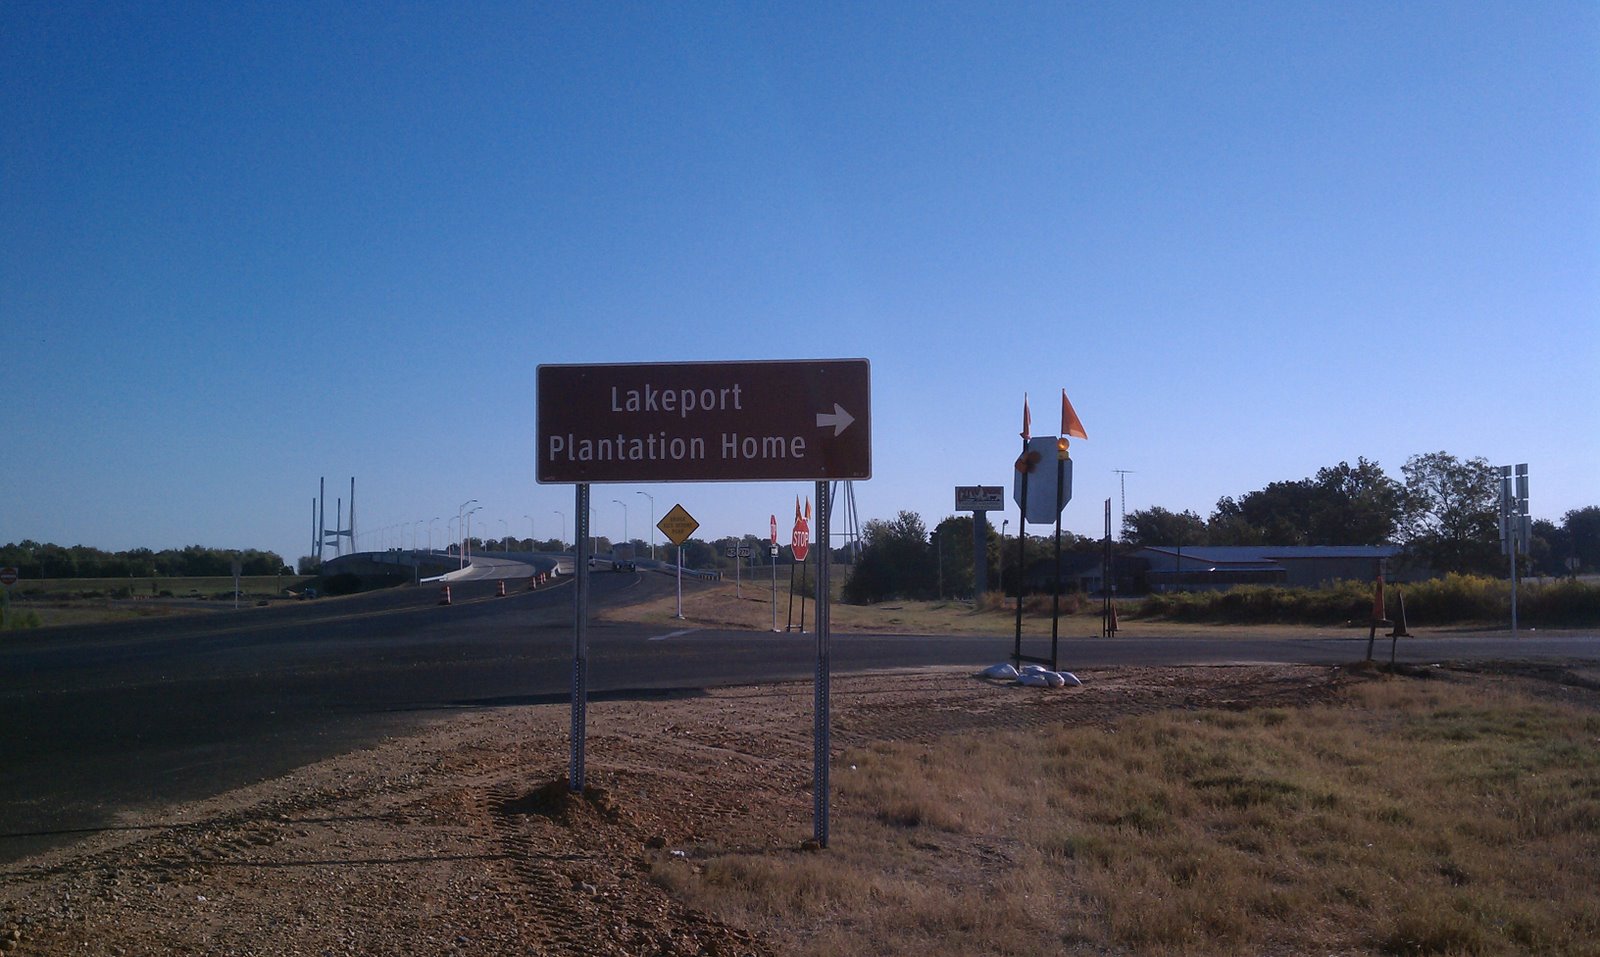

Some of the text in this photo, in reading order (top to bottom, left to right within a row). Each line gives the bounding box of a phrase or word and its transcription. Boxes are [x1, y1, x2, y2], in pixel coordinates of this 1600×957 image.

[611, 384, 742, 418] Lakeport
[550, 432, 806, 461] Plantation Home
[793, 531, 808, 547] STOP
